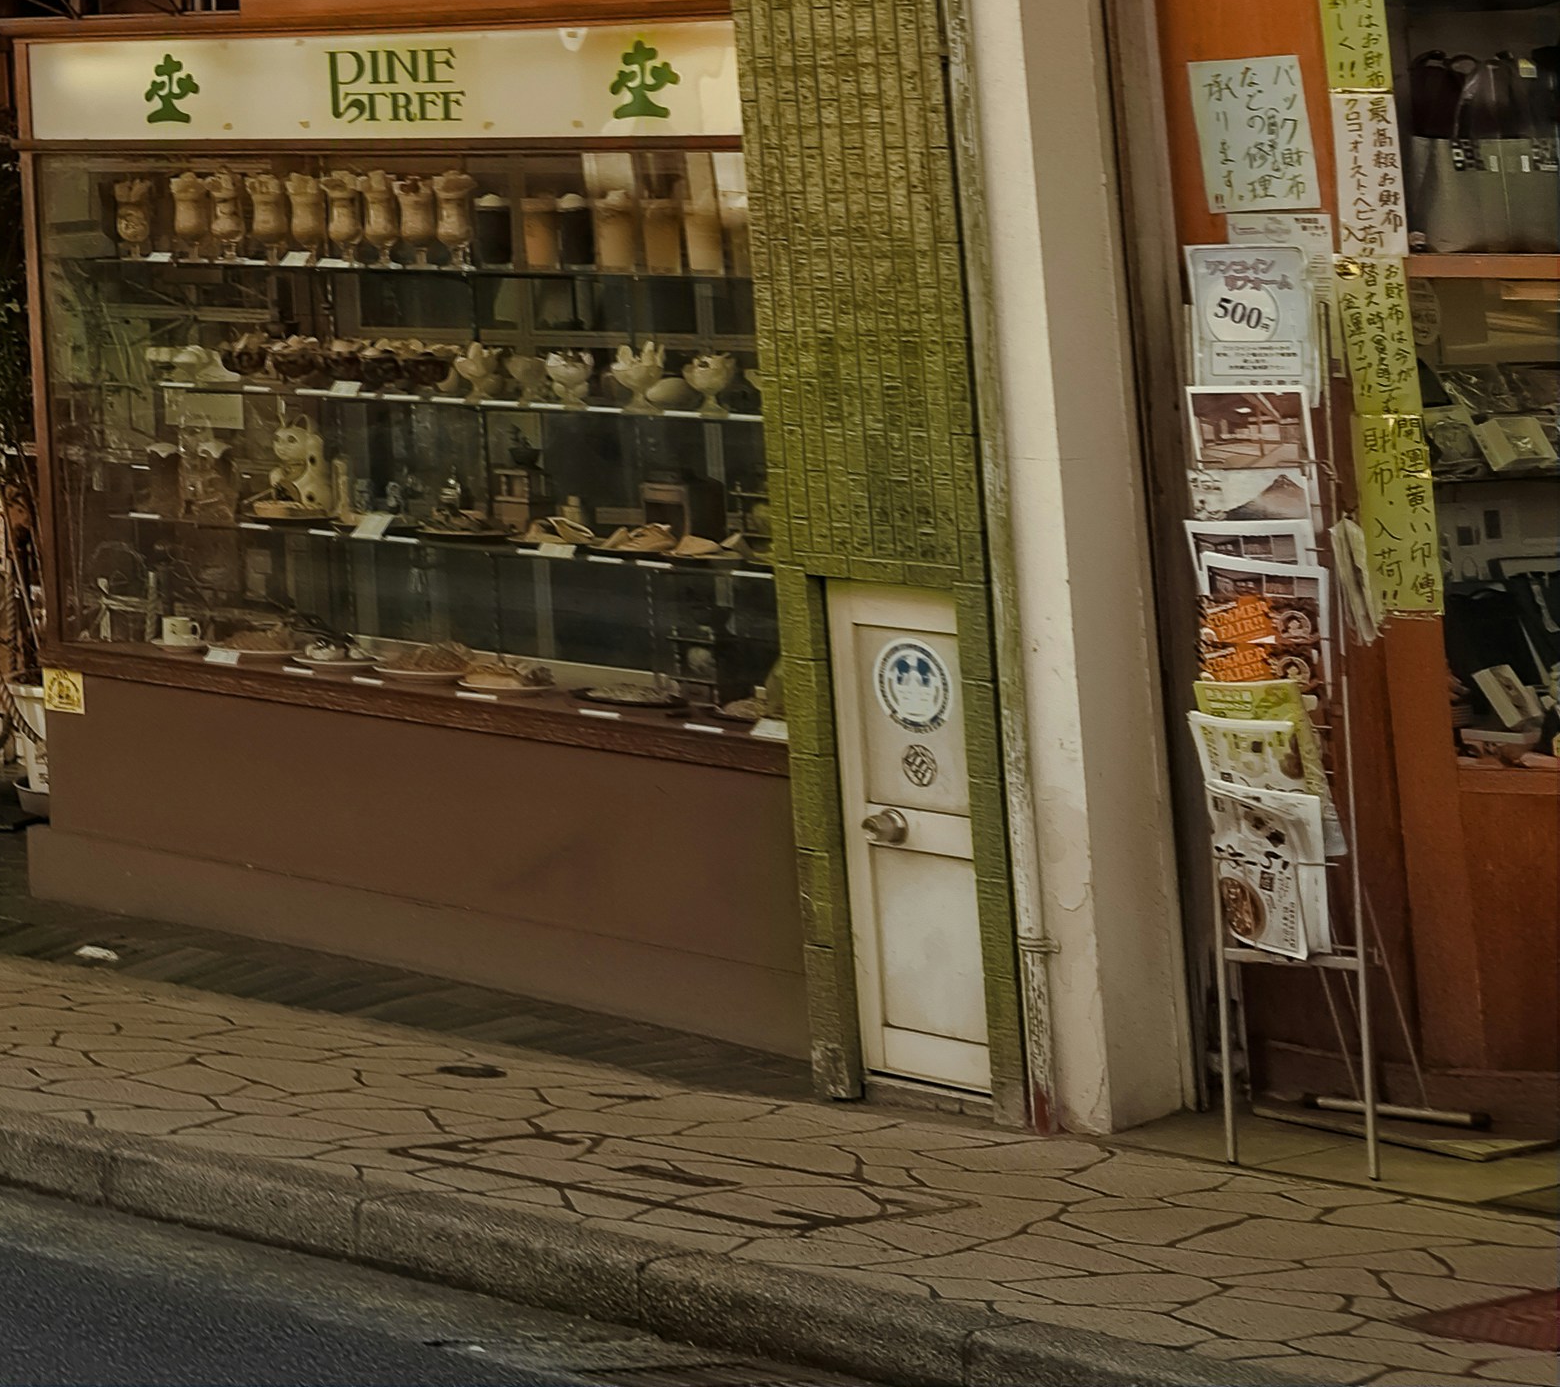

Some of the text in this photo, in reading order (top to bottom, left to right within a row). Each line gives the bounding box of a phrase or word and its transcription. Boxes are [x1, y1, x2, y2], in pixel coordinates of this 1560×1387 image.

[325, 48, 456, 101] PINE
[347, 89, 465, 123] TREE
[1213, 297, 1262, 330] 500
